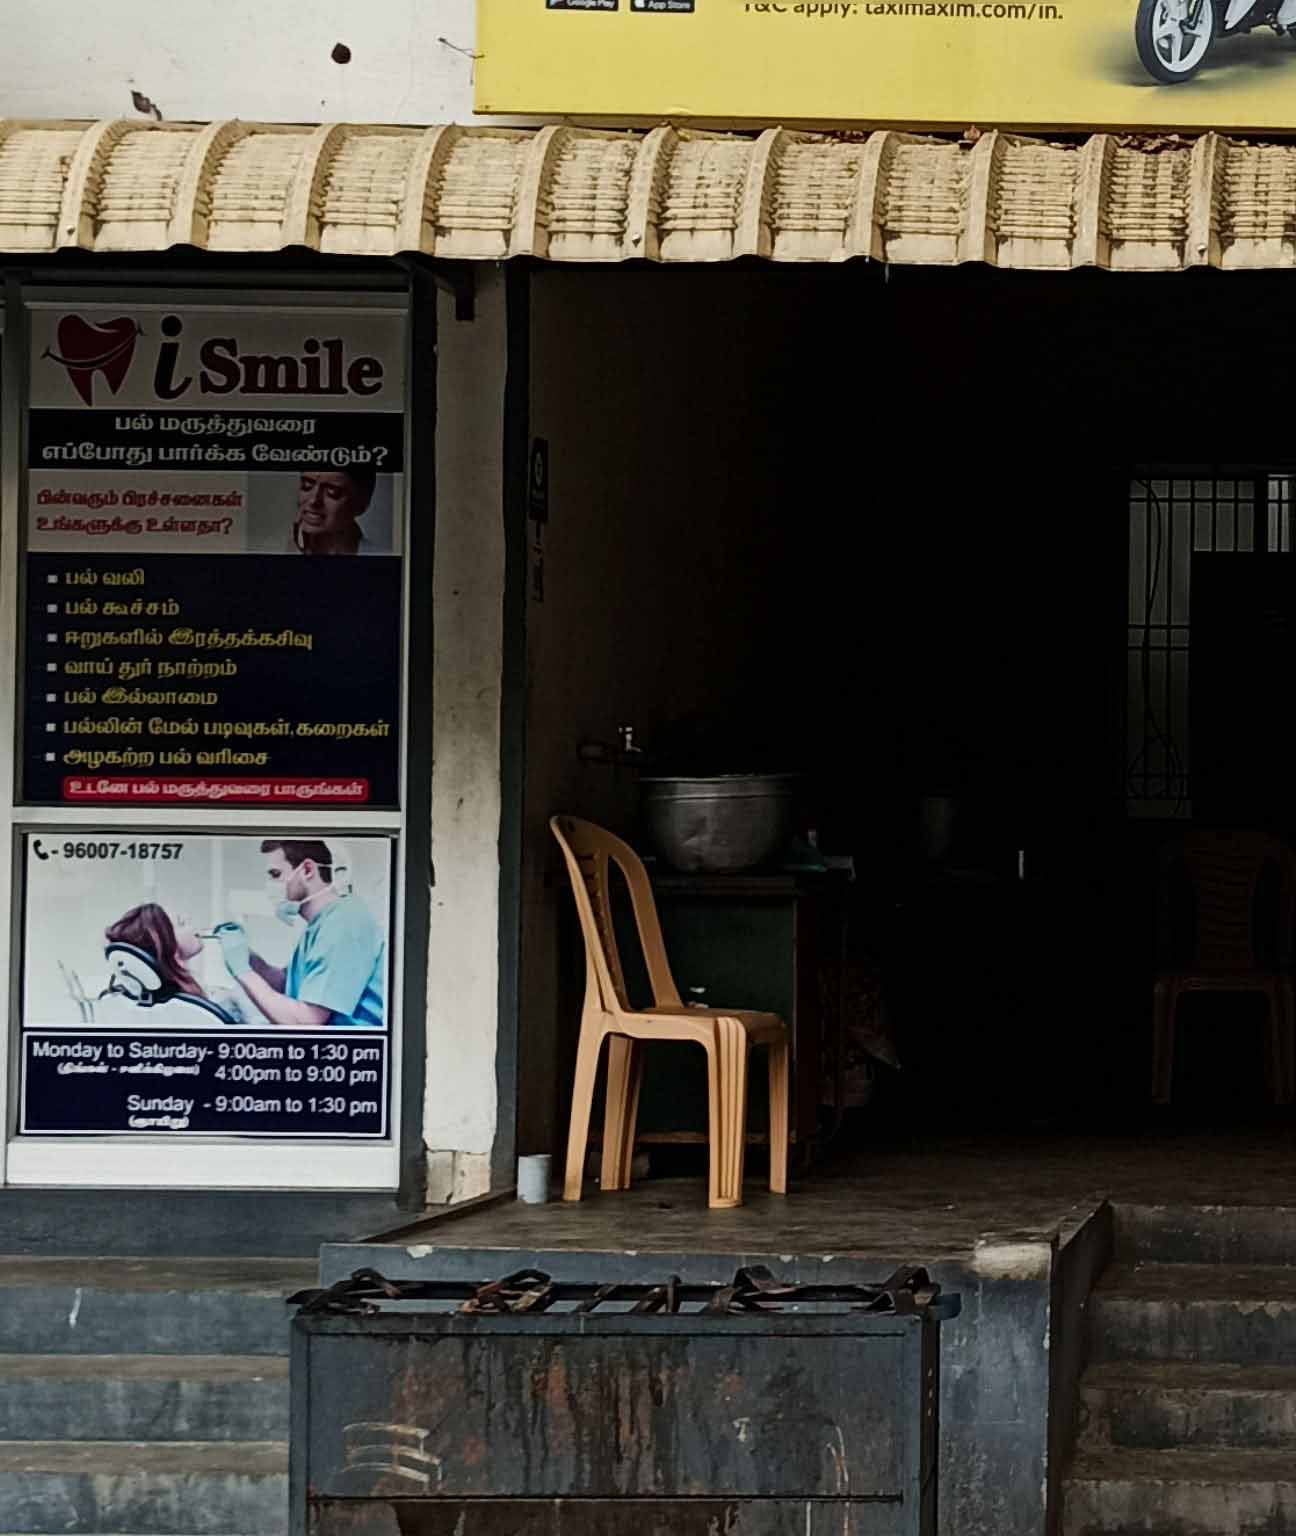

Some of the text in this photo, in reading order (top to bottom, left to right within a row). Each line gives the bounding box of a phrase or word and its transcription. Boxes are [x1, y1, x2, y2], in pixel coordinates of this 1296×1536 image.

[115, 414, 316, 436] பல் மருத்துவரை
[42, 442, 389, 467] எப்போது பார்க்க வேண்டும்?
[64, 569, 145, 587] பல் வலி
[64, 599, 180, 617] பல் கூச்சம்
[64, 629, 163, 650] ஈறுகளில்
[64, 659, 114, 676] வாய்
[157, 659, 237, 678] நாற்றம்
[64, 688, 218, 706] பல் இல்லாமை
[63, 718, 143, 736] பல்லின்
[148, 718, 200, 736] மேல்
[63, 748, 272, 769] அழகற்ற பல் வரிசை
[132, 780, 161, 796] பல்
[63, 843, 184, 860] 96007-18757
[32, 1042, 103, 1061] Monday
[107, 1043, 124, 1058] to
[217, 1044, 284, 1060] 9:00am
[287, 1044, 305, 1060] to
[310, 1044, 349, 1061] 1:30
[352, 1048, 380, 1064] pm
[213, 1065, 378, 1086] 4:00pm to 9:00 pm
[127, 1095, 194, 1115] Sunday
[215, 1096, 281, 1112] 9:00am
[285, 1097, 303, 1112] to
[308, 1097, 346, 1113] 1:30
[349, 1101, 378, 1116] pm
